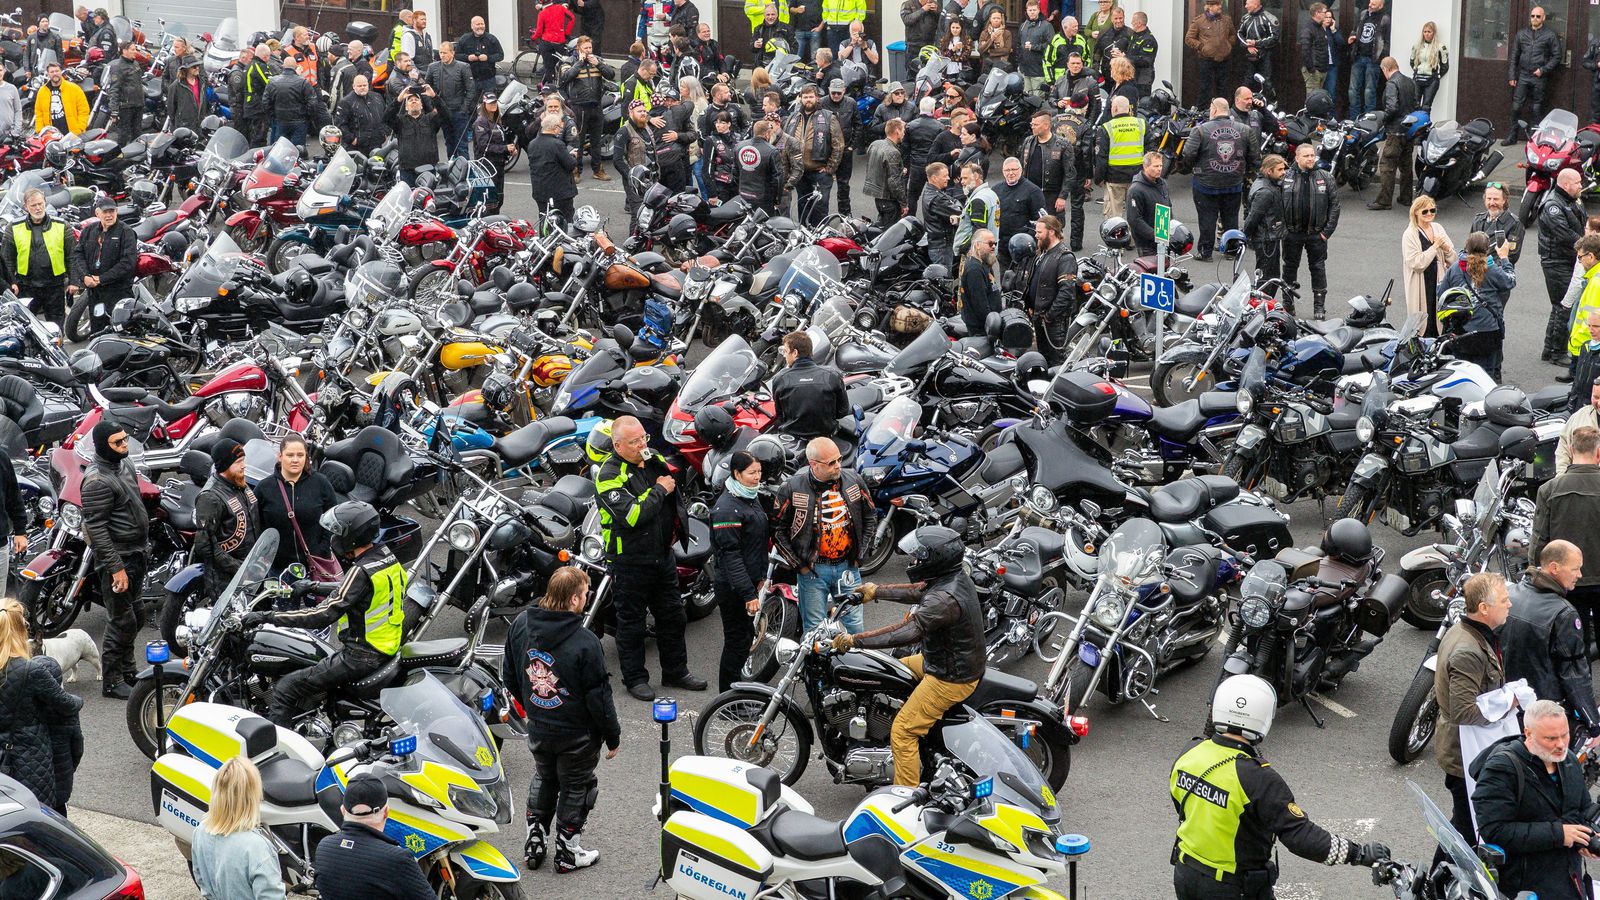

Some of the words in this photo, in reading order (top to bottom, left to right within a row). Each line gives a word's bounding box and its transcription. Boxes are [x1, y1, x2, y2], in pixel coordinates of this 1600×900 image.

[1144, 279, 1156, 304] P
[936, 841, 955, 853] 329
[679, 863, 747, 900] LÖGREGLAN
